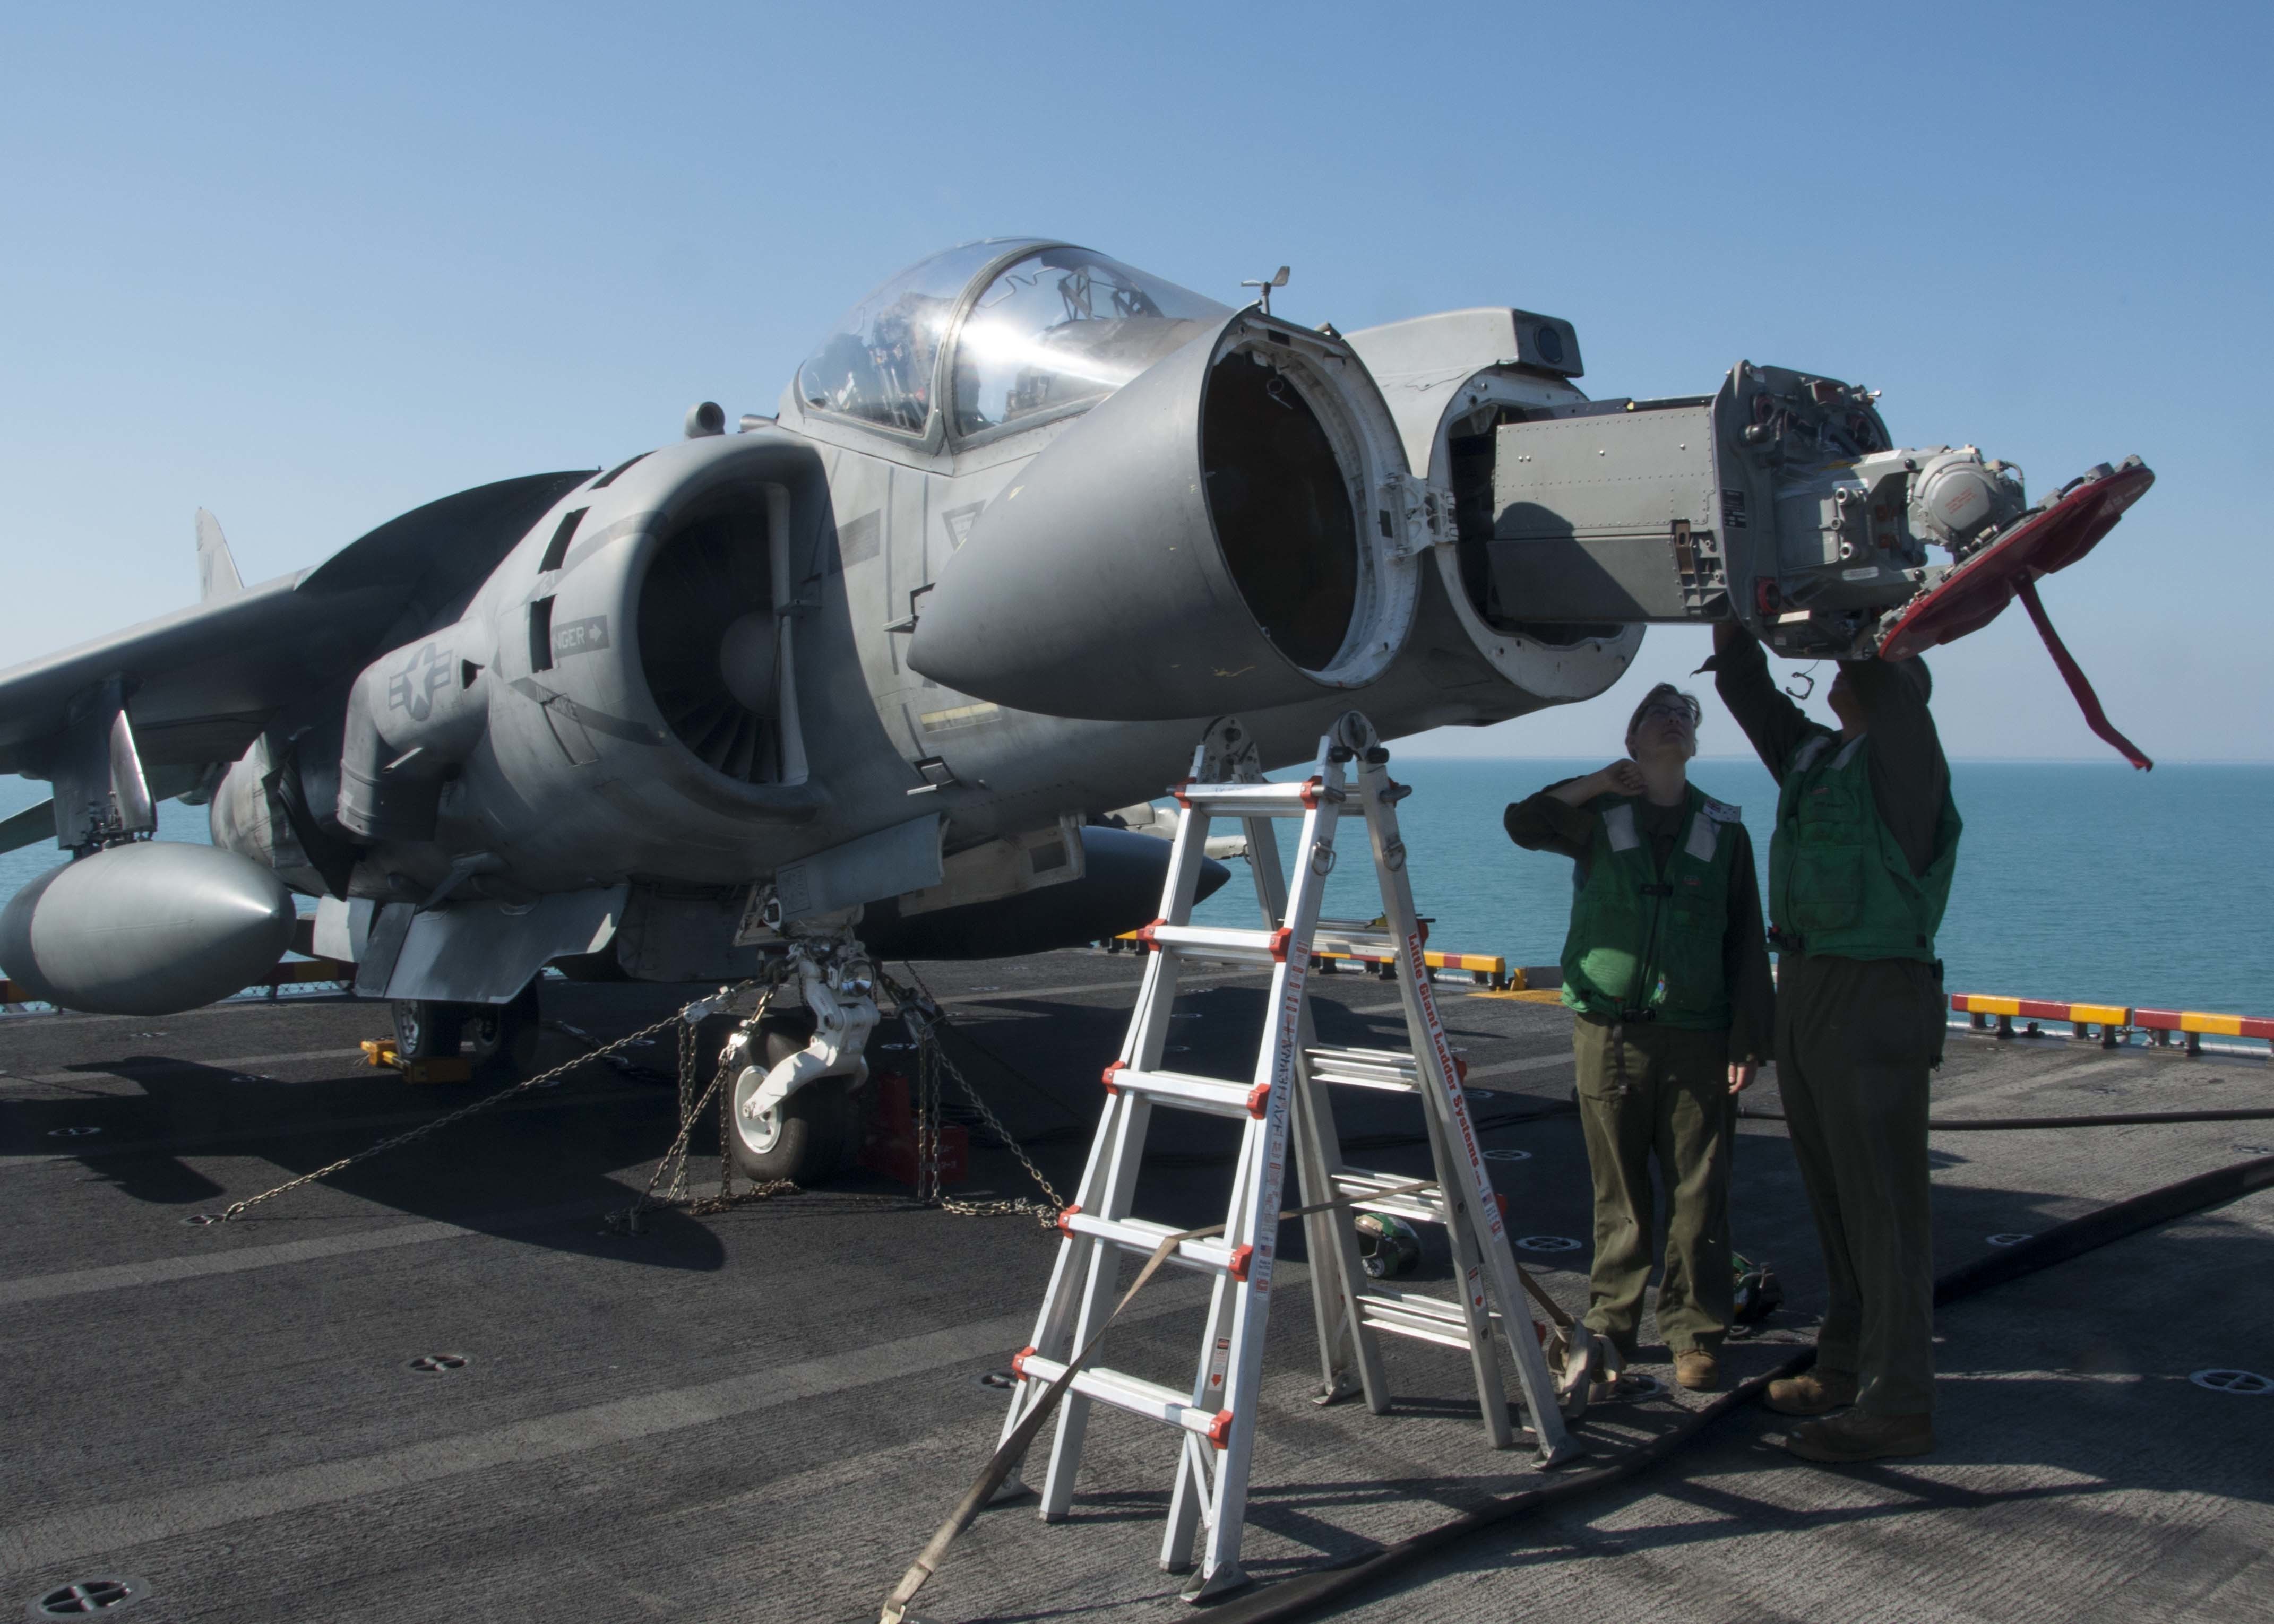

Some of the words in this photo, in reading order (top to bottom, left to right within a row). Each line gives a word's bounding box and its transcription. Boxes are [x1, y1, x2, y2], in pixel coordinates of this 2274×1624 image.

[1408, 933, 1423, 979] Little
[1419, 983, 1439, 1029] Giant
[1434, 1031, 1457, 1091] Ladder
